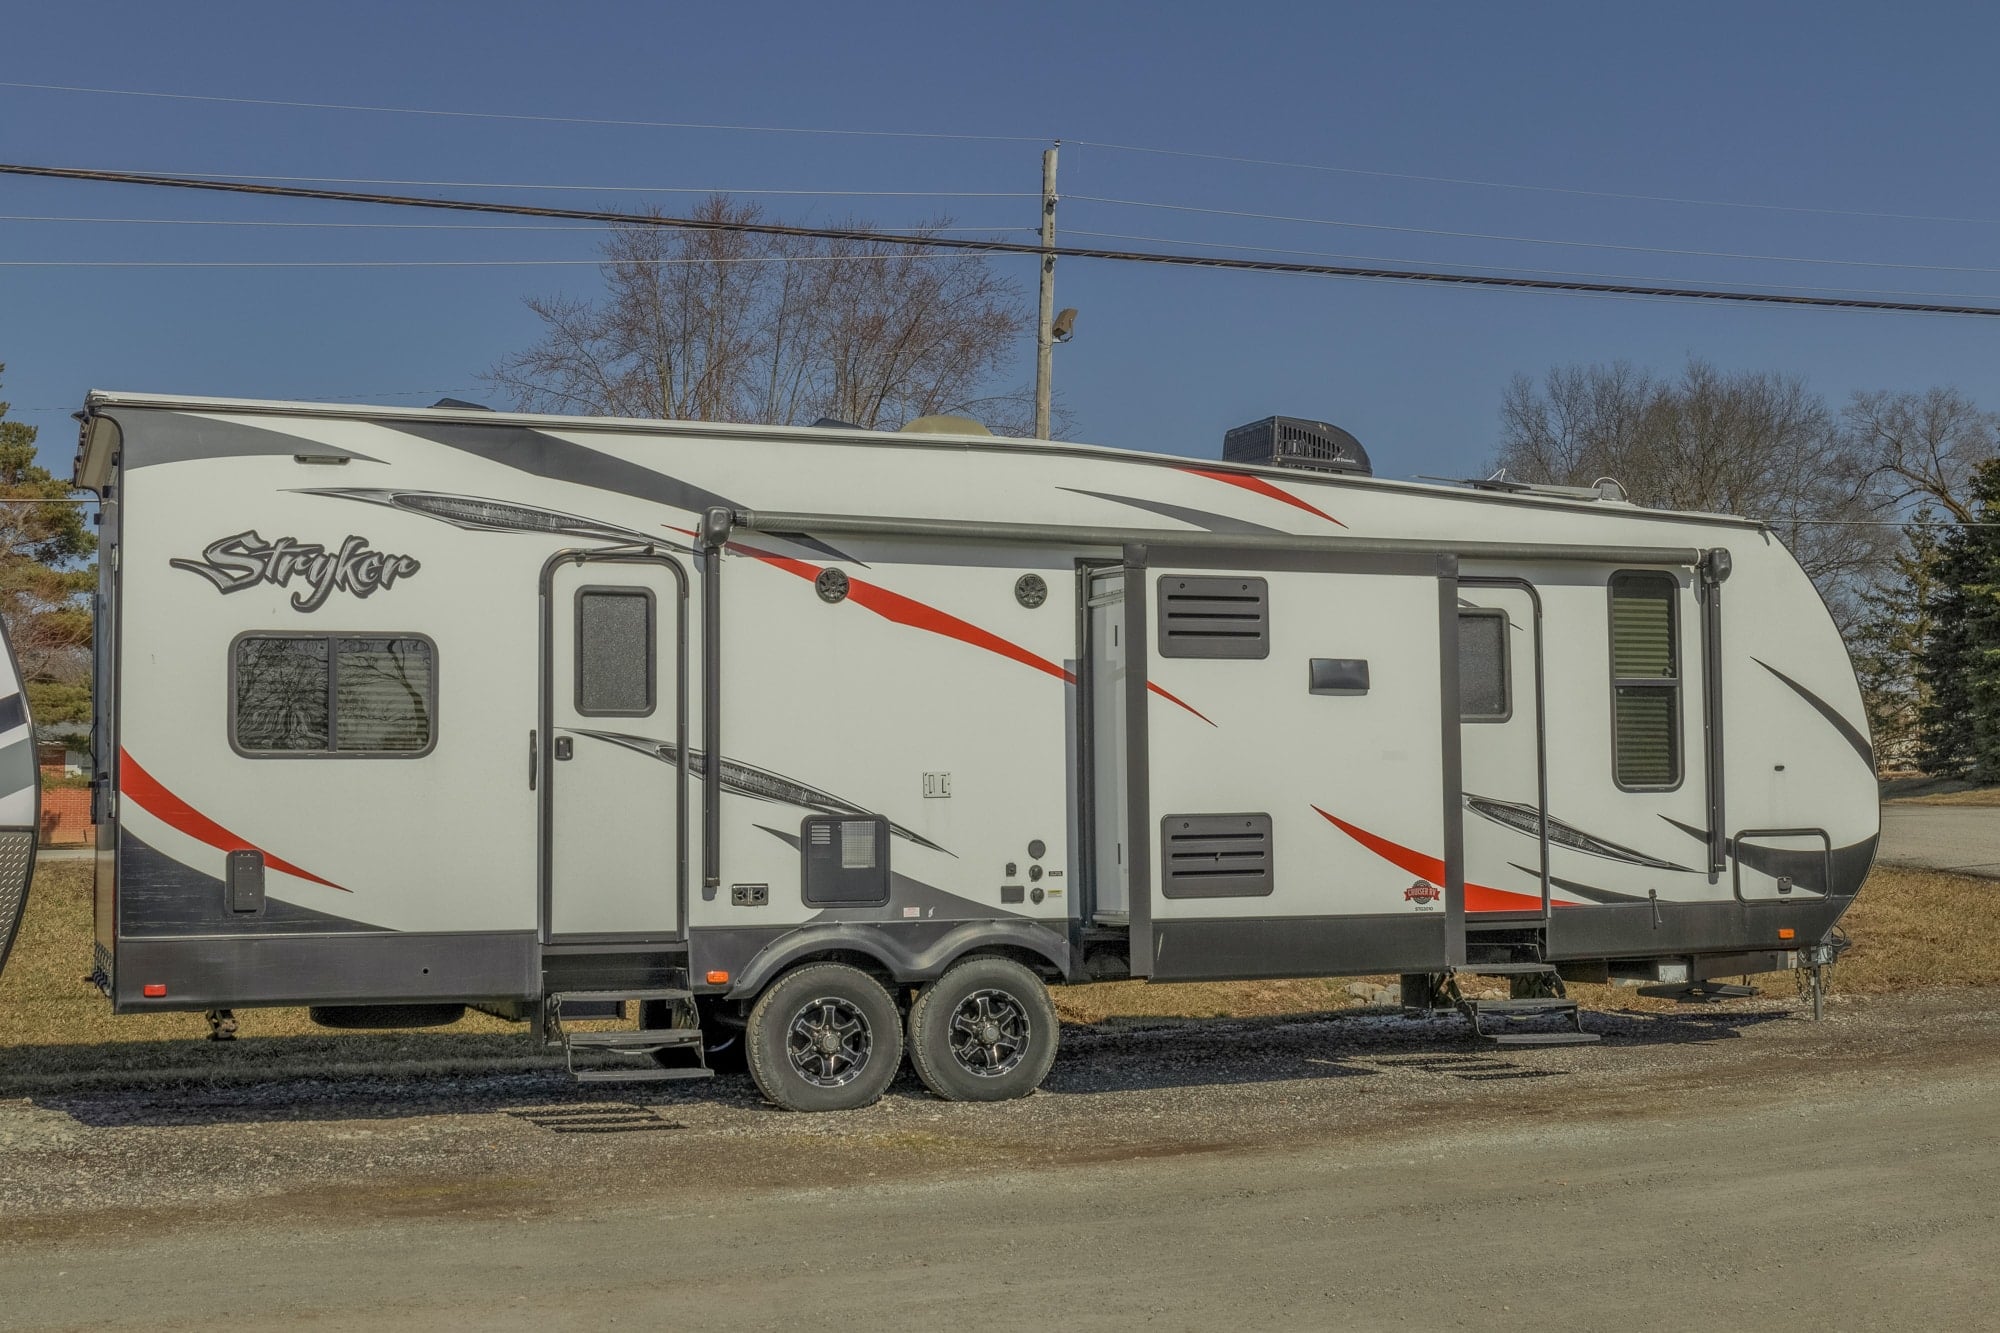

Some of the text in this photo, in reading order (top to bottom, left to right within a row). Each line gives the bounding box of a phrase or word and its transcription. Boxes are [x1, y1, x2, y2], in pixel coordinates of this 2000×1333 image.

[169, 529, 421, 613] Stryker
[1408, 887, 1436, 897] CRUISER RV
